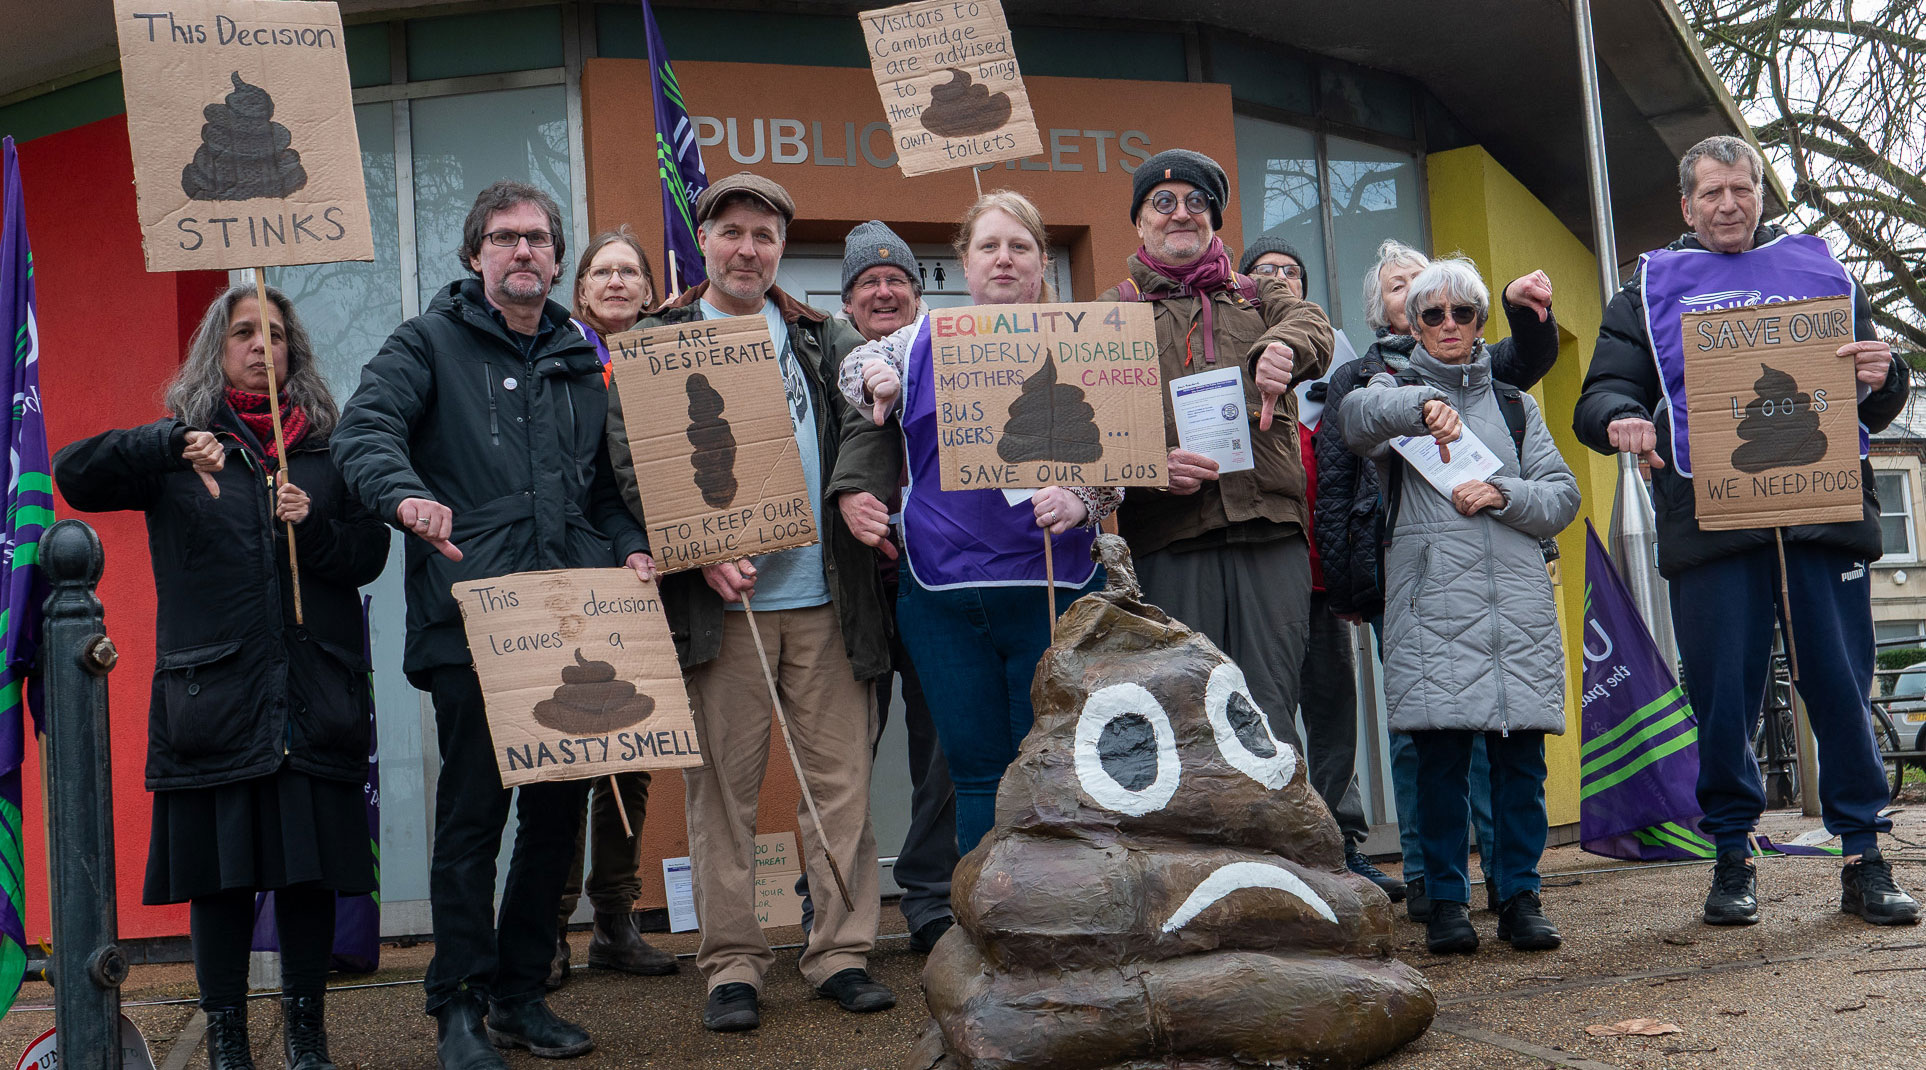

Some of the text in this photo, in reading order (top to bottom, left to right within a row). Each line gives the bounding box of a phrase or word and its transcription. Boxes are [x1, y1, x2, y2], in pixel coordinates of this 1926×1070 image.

[133, 12, 336, 48] This Decision
[870, 2, 979, 35] Visitors to
[875, 26, 979, 58] Cambridge
[886, 36, 1007, 75] are advised
[894, 60, 1015, 98] to bring
[889, 104, 923, 122] their
[690, 116, 899, 169] PUBLIC
[901, 132, 1016, 159] own toilets
[177, 207, 346, 250] STINKS
[936, 306, 1126, 337] EQUALITY 4
[1697, 308, 1849, 351] SAVE OUR
[618, 328, 719, 360] WE ARE
[649, 340, 775, 375] DESPERATE
[941, 341, 1155, 365] ELDERLY DISABLED
[940, 369, 1025, 391] MOTHERS
[1081, 368, 1158, 387] CARERS
[942, 401, 984, 424] BUS
[942, 426, 995, 447] USERS
[960, 464, 1157, 485] SAVE OUR LOOS
[1707, 470, 1860, 500] WE NEED POOS
[655, 498, 808, 544] TO KEEP OUR
[661, 519, 811, 567] PUBLIC LOOS
[1841, 568, 1864, 582] PUMA
[469, 586, 659, 617] This decision
[489, 631, 624, 656] leaves a
[506, 730, 701, 771] NASTY SMELL
[776, 843, 785, 853] IS
[760, 888, 784, 897] YOUR
